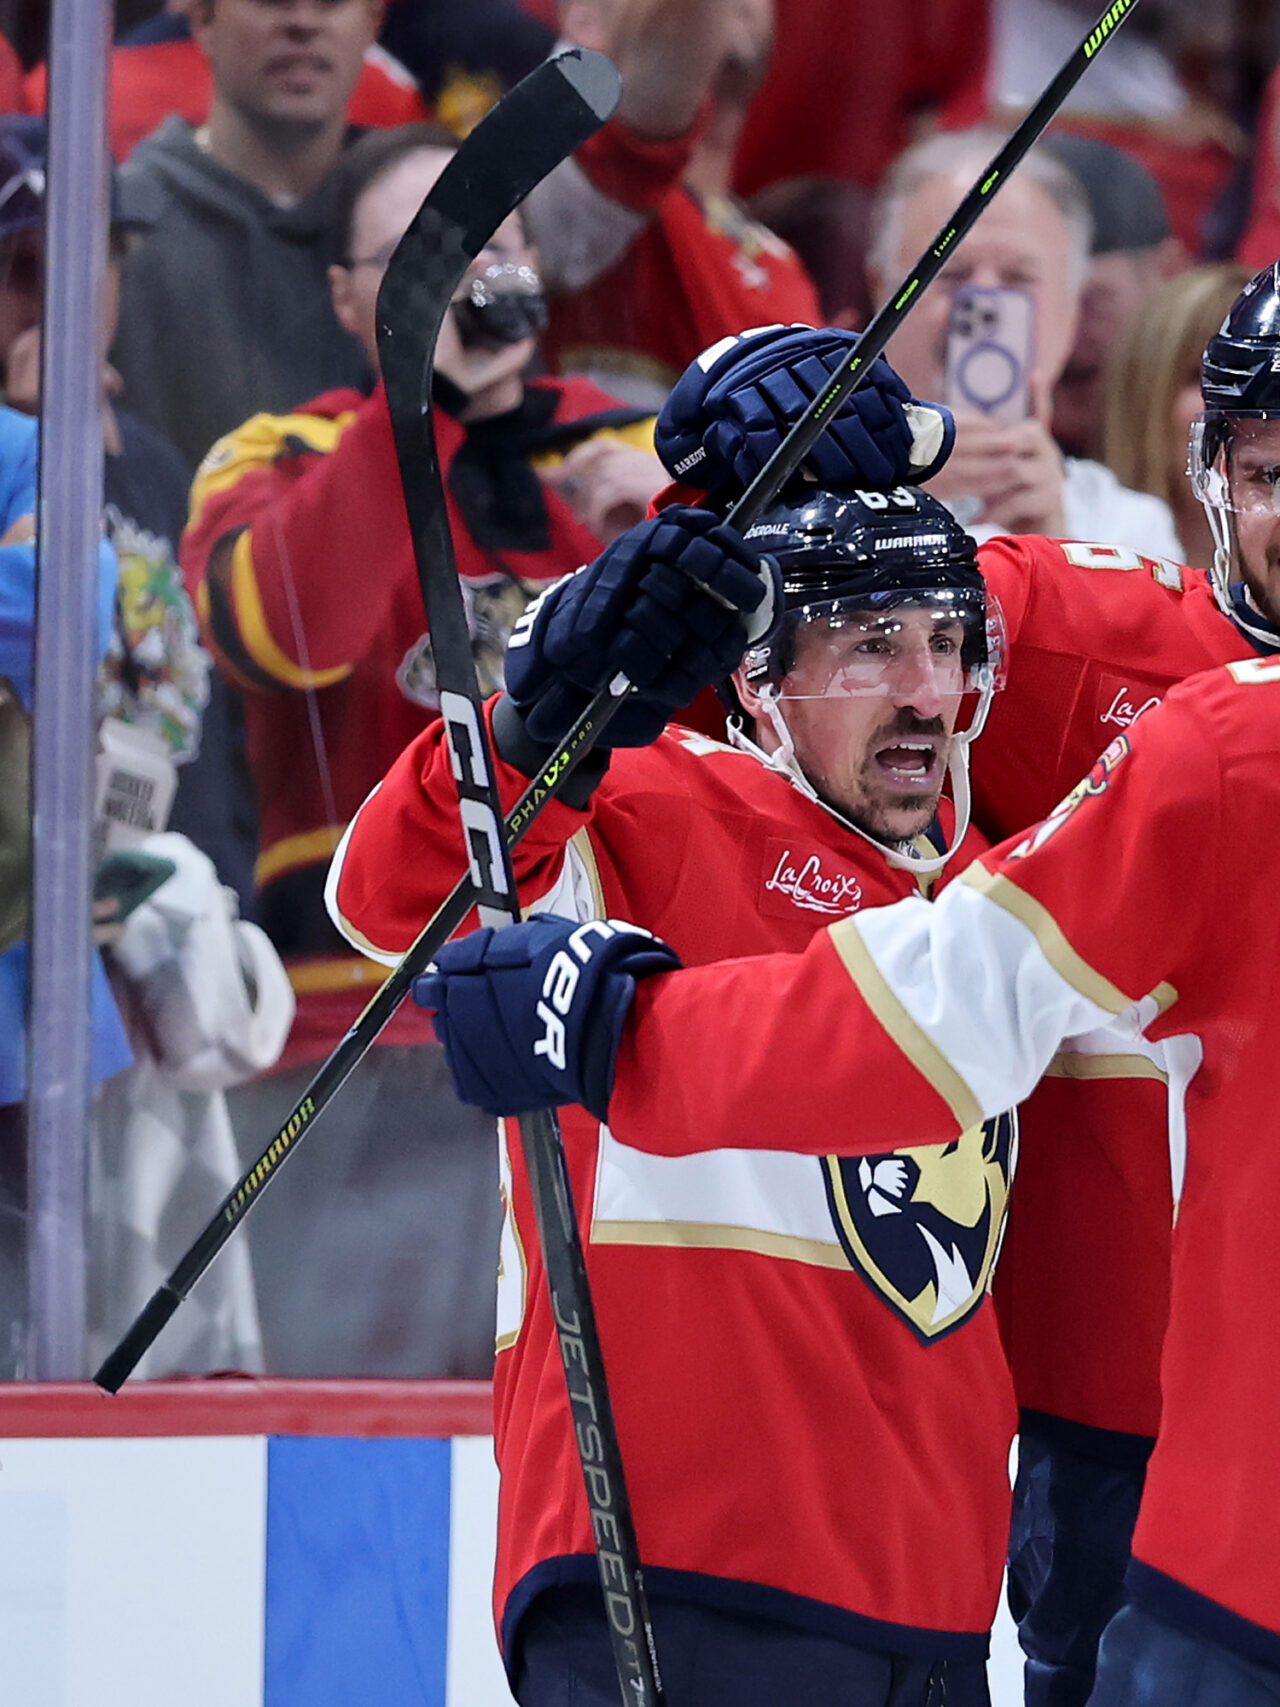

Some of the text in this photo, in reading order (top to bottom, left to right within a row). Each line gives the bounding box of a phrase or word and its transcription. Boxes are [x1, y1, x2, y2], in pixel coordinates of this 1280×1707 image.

[1083, 0, 1131, 58] WAR
[440, 691, 514, 930] CC
[553, 1291, 635, 1637] JETSPEED
